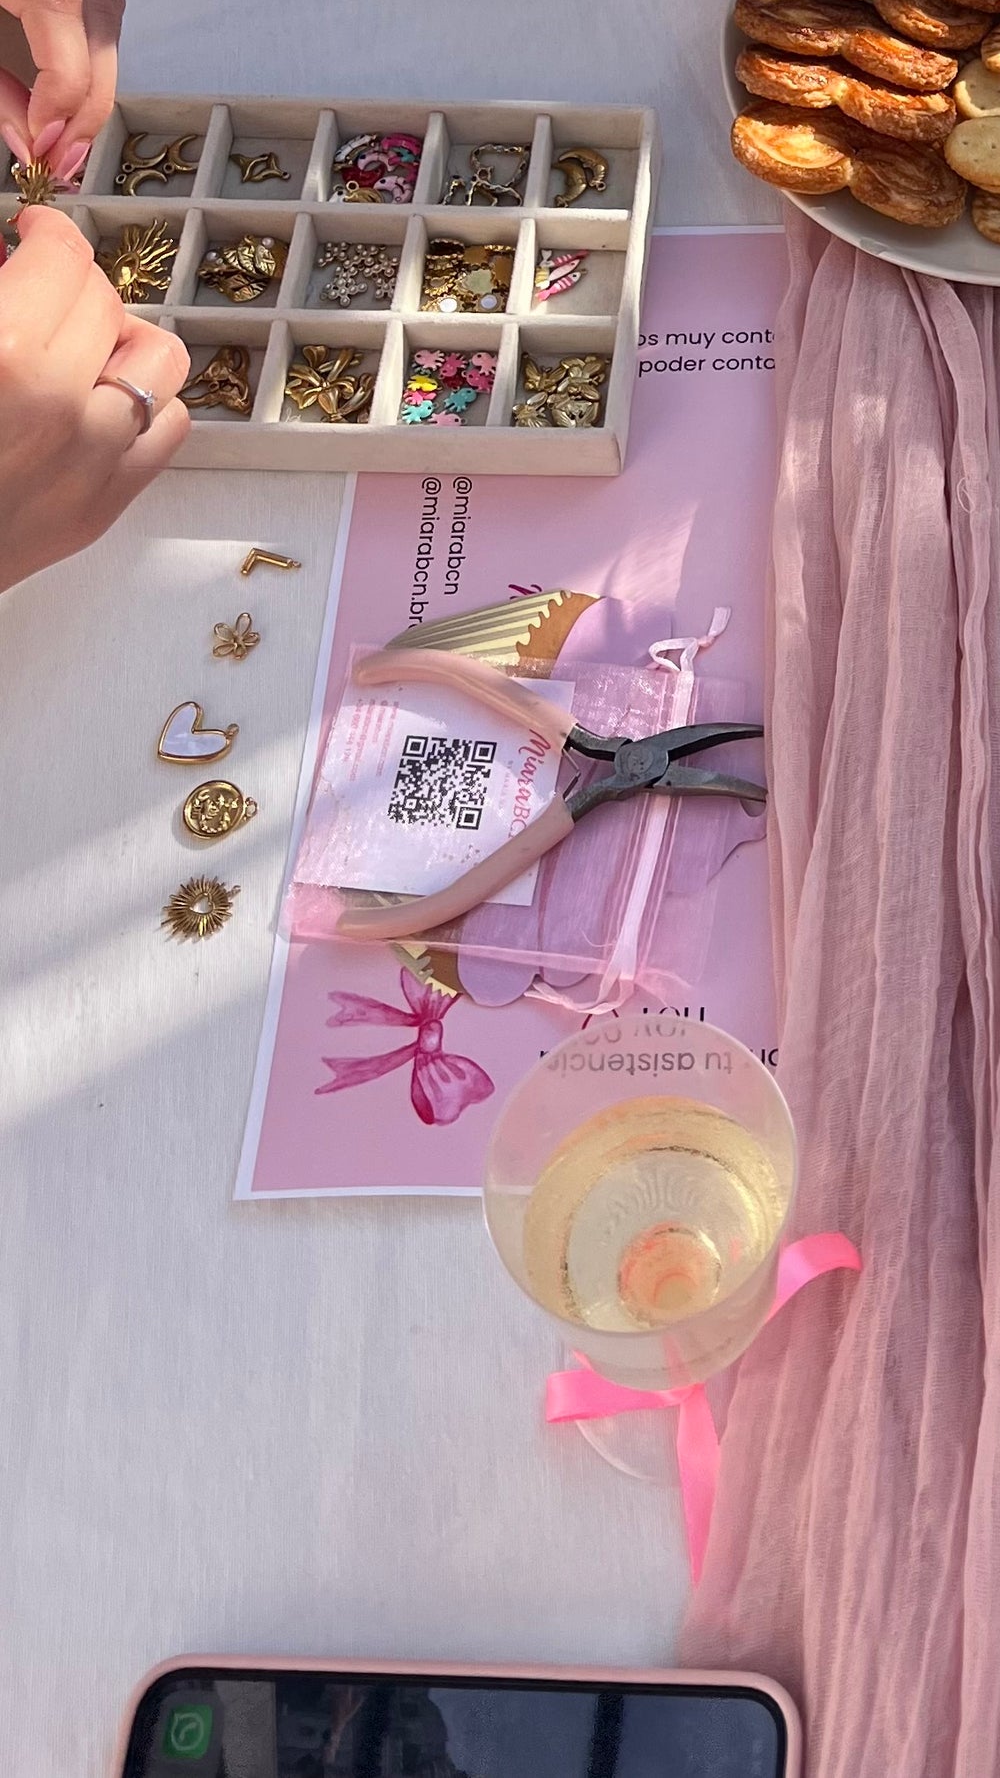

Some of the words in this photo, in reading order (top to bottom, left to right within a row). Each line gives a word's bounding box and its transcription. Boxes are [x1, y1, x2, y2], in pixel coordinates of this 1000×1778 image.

[638, 355, 707, 378] poder
[711, 354, 776, 371] conta
[665, 332, 717, 350] muy
[408, 476, 442, 629] @miarabcn.br
[443, 476, 473, 596] @miarabcn
[510, 728, 552, 838] MiaraBC
